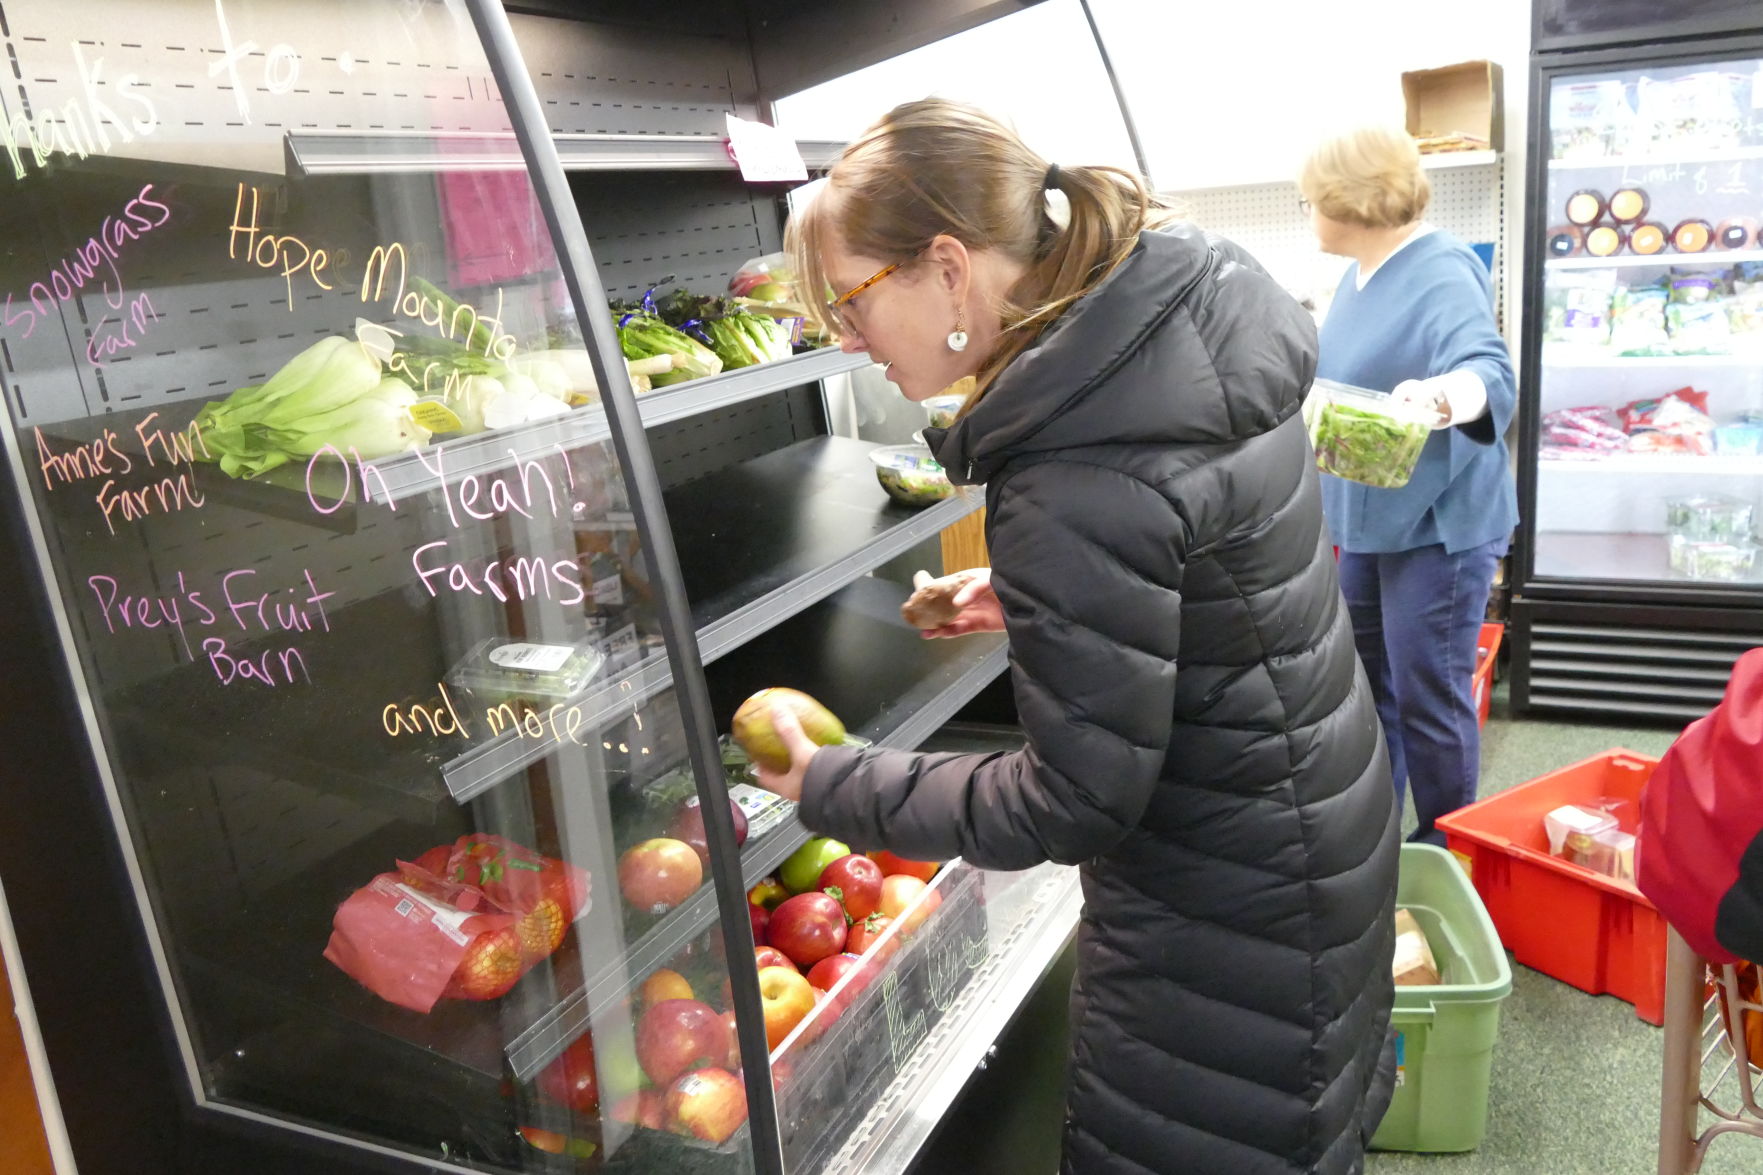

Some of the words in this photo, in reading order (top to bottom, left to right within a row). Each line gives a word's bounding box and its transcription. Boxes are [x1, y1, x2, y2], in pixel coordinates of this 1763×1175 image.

[4, 184, 170, 339] Snowgrass
[229, 182, 333, 312] Hope
[135, 412, 211, 468] Fun
[96, 475, 206, 536] Farm
[306, 442, 397, 515] Oh
[413, 443, 586, 528] Yeah!
[411, 540, 586, 606] Farms
[87, 571, 217, 662] Prey's
[222, 568, 337, 633] Fruit
[202, 637, 313, 687] Barn
[382, 681, 470, 739] and
